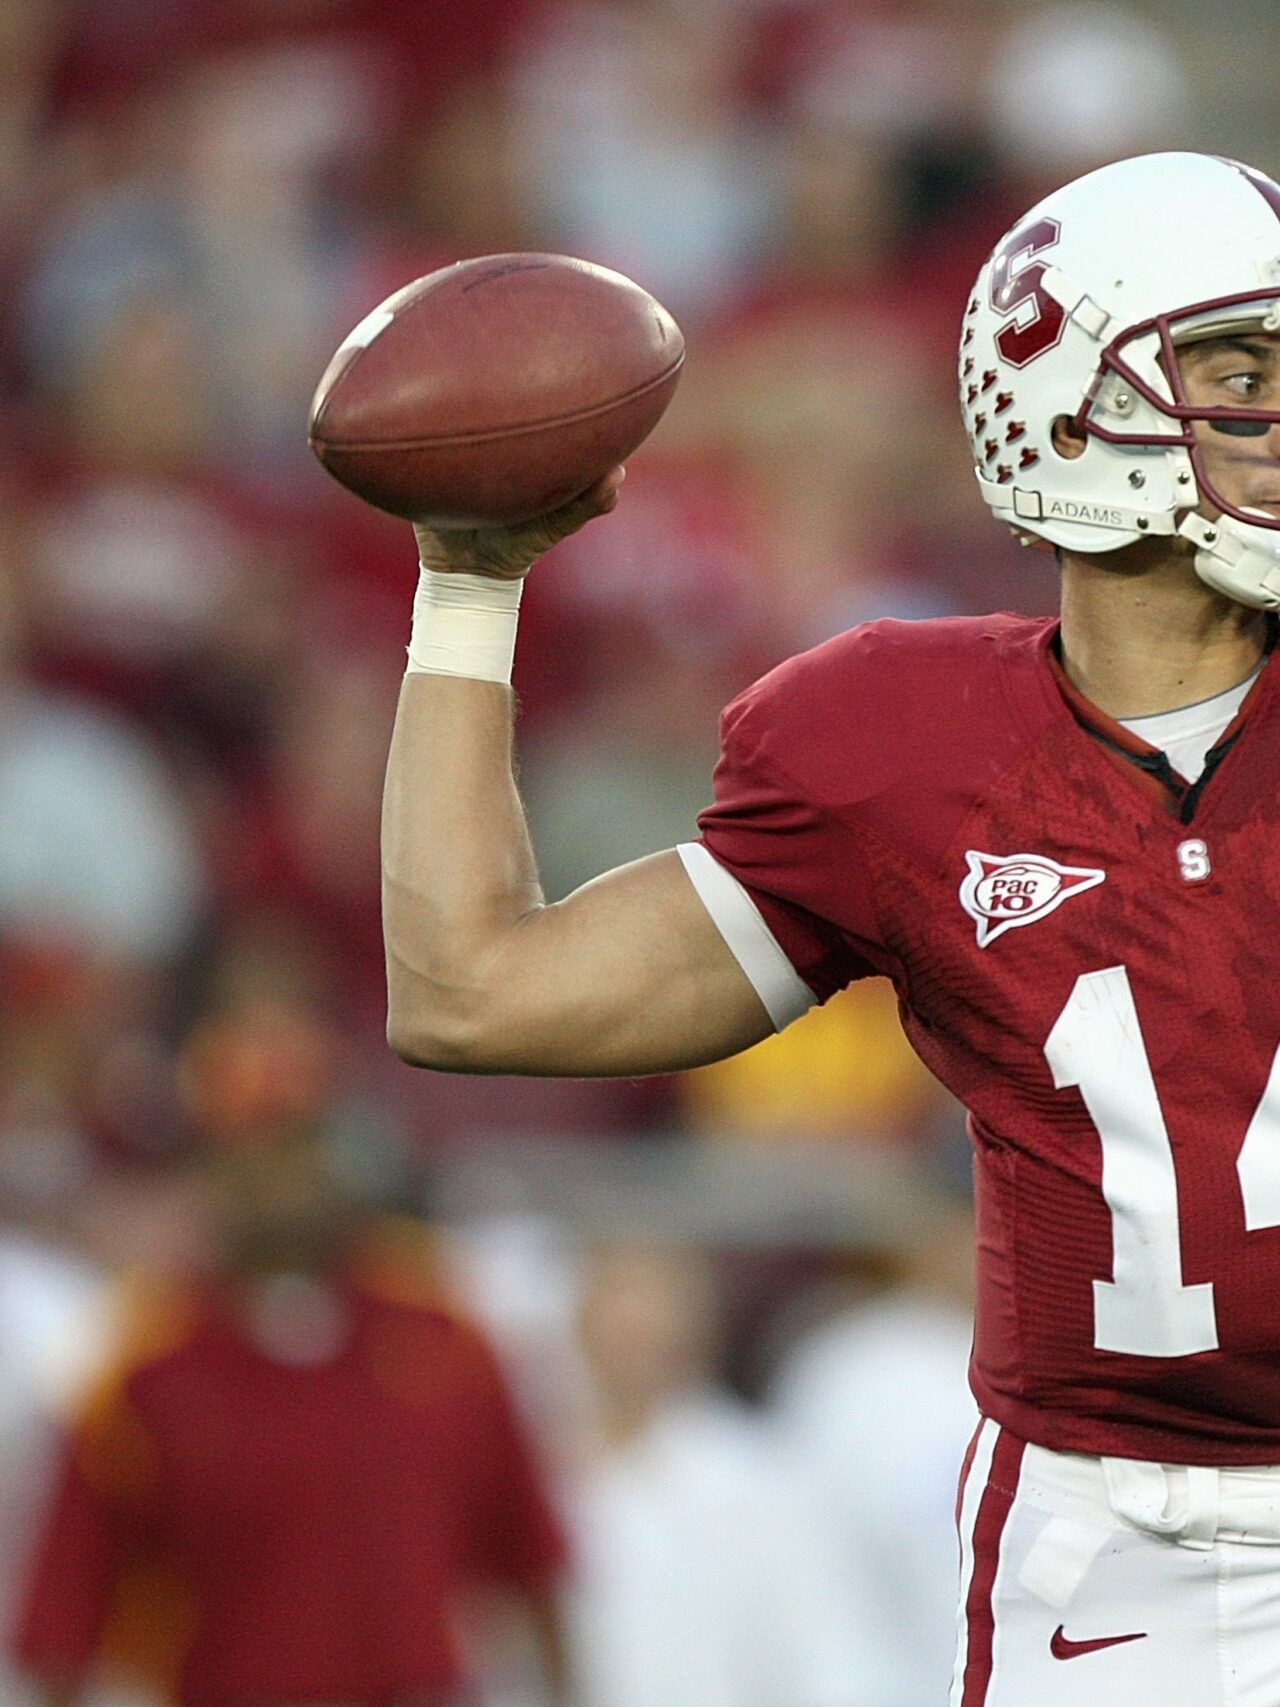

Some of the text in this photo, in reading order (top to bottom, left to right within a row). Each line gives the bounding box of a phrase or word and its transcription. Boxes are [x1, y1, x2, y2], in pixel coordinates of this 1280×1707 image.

[989, 216, 1069, 370] S
[1050, 501, 1122, 526] ADAMS
[1177, 838, 1211, 880] S
[988, 895, 1033, 911] 10
